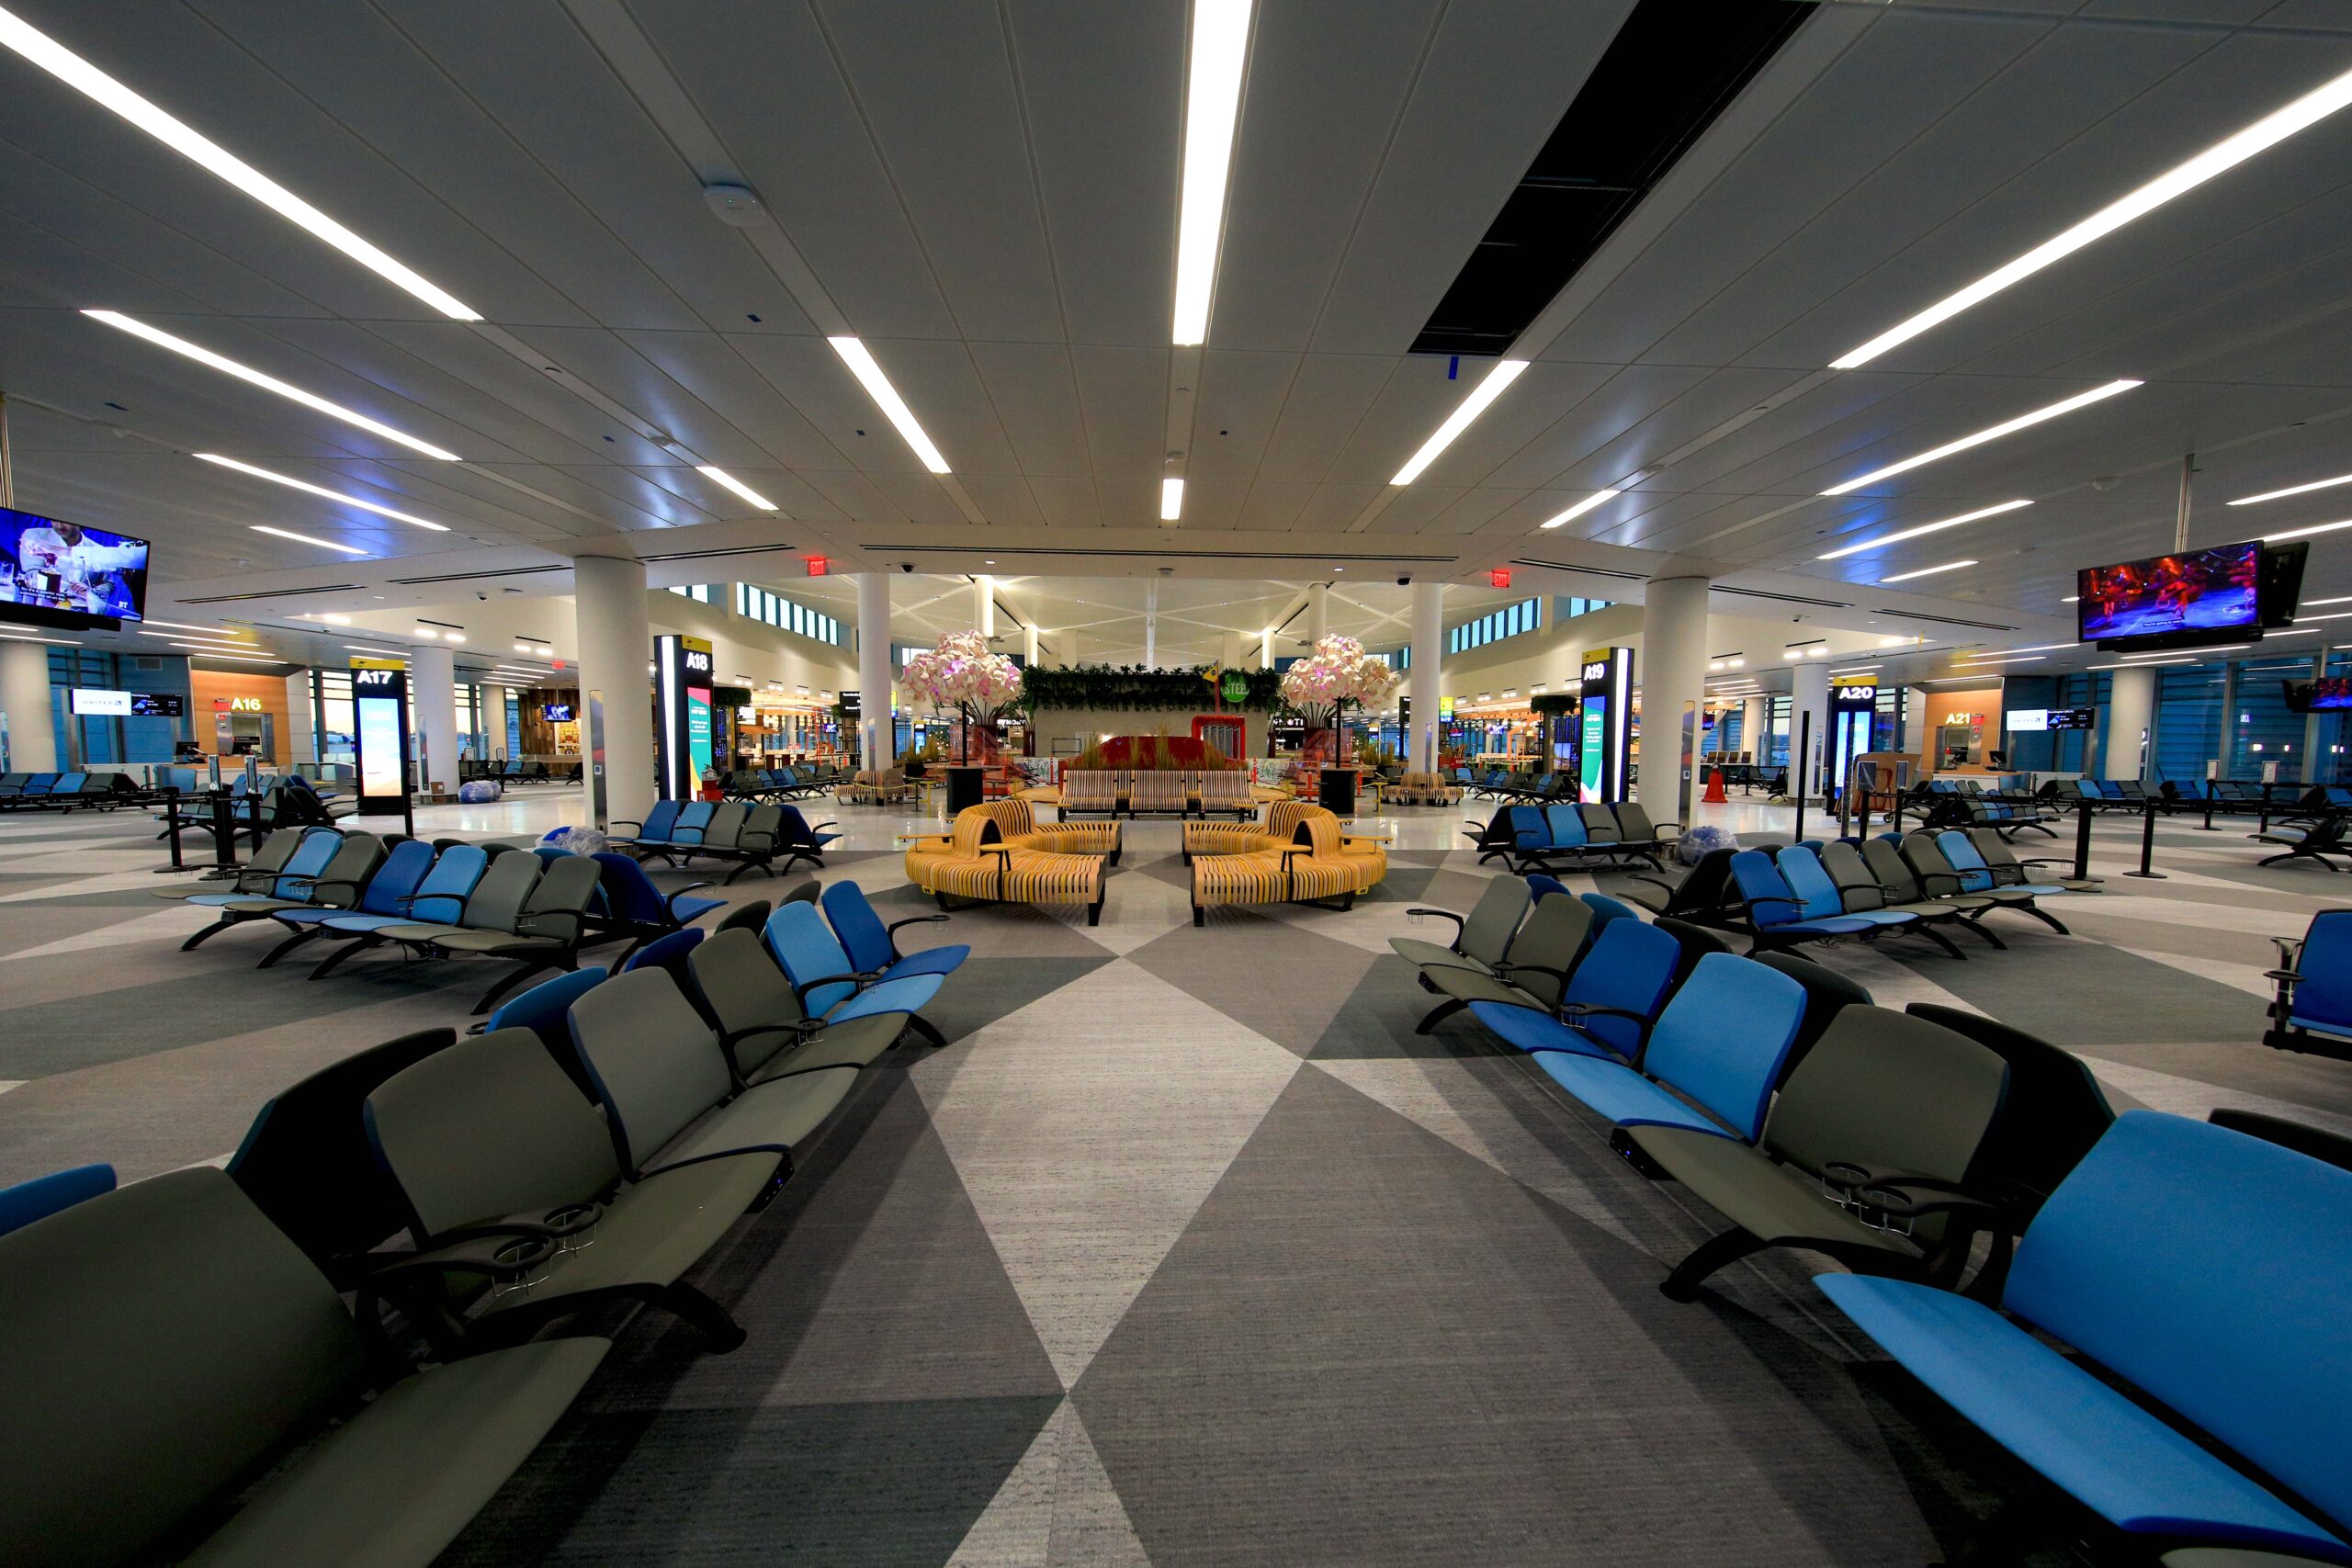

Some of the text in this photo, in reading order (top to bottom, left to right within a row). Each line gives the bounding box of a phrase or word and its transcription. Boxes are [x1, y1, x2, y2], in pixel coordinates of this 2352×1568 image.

[686, 652, 707, 671] A18
[356, 671, 392, 683] A17
[1584, 663, 1604, 681] A19
[1838, 686, 1873, 700] A20
[231, 697, 262, 711] A16
[1945, 712, 1971, 724] A21
